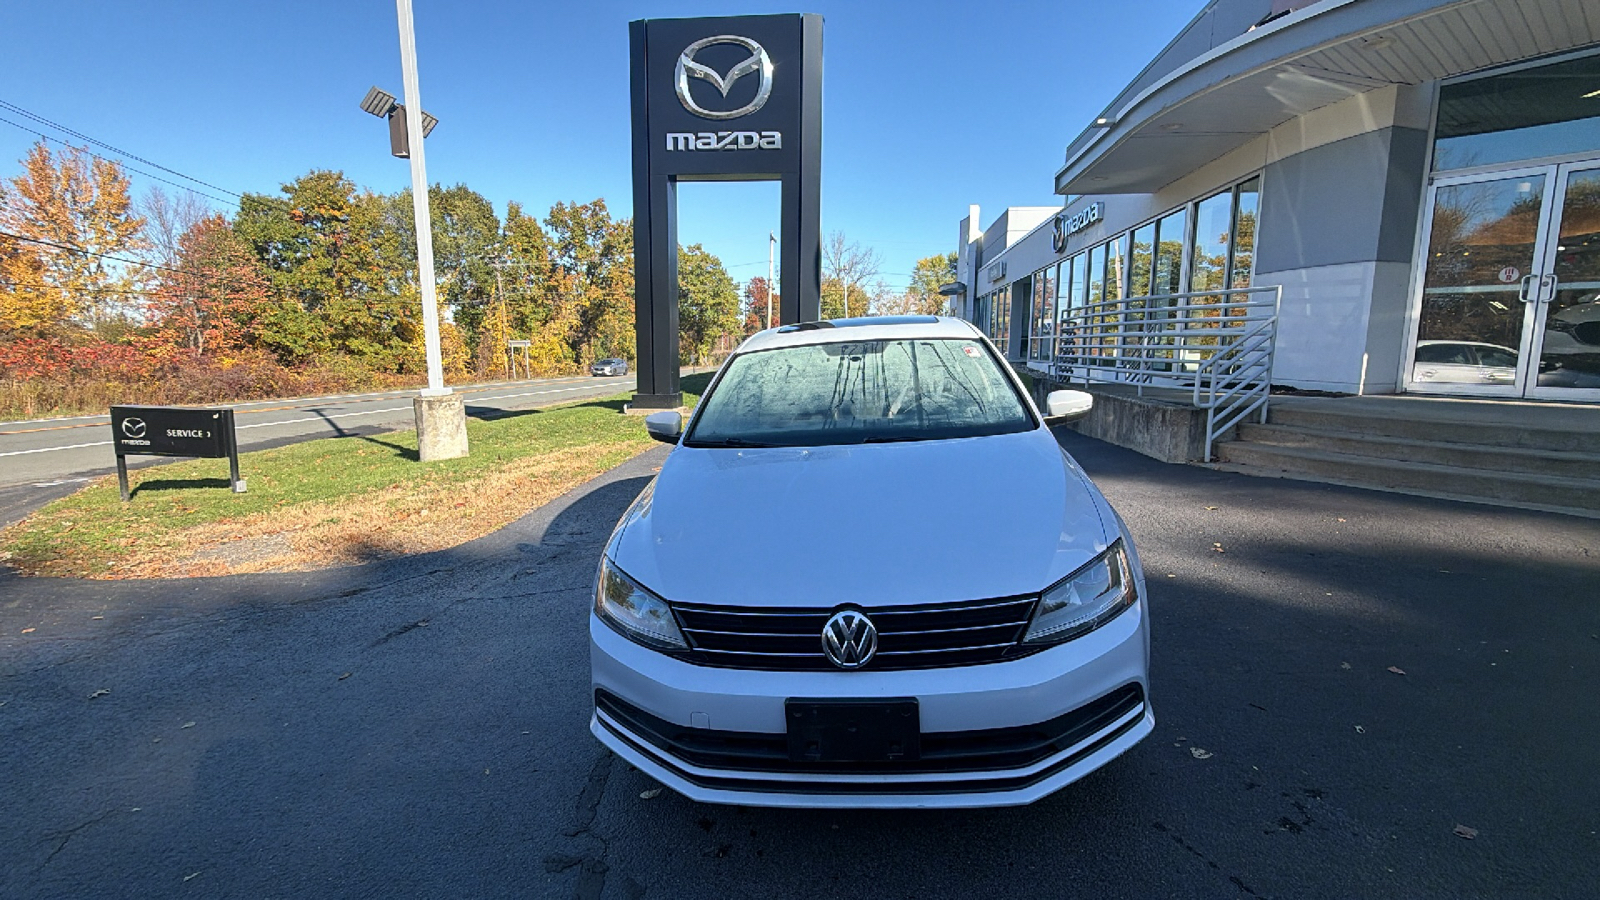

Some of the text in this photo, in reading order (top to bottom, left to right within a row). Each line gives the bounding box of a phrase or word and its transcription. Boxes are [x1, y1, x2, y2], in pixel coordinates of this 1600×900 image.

[666, 131, 782, 151] mazda
[1065, 202, 1098, 237] mazda
[166, 429, 203, 438] SERVICE
